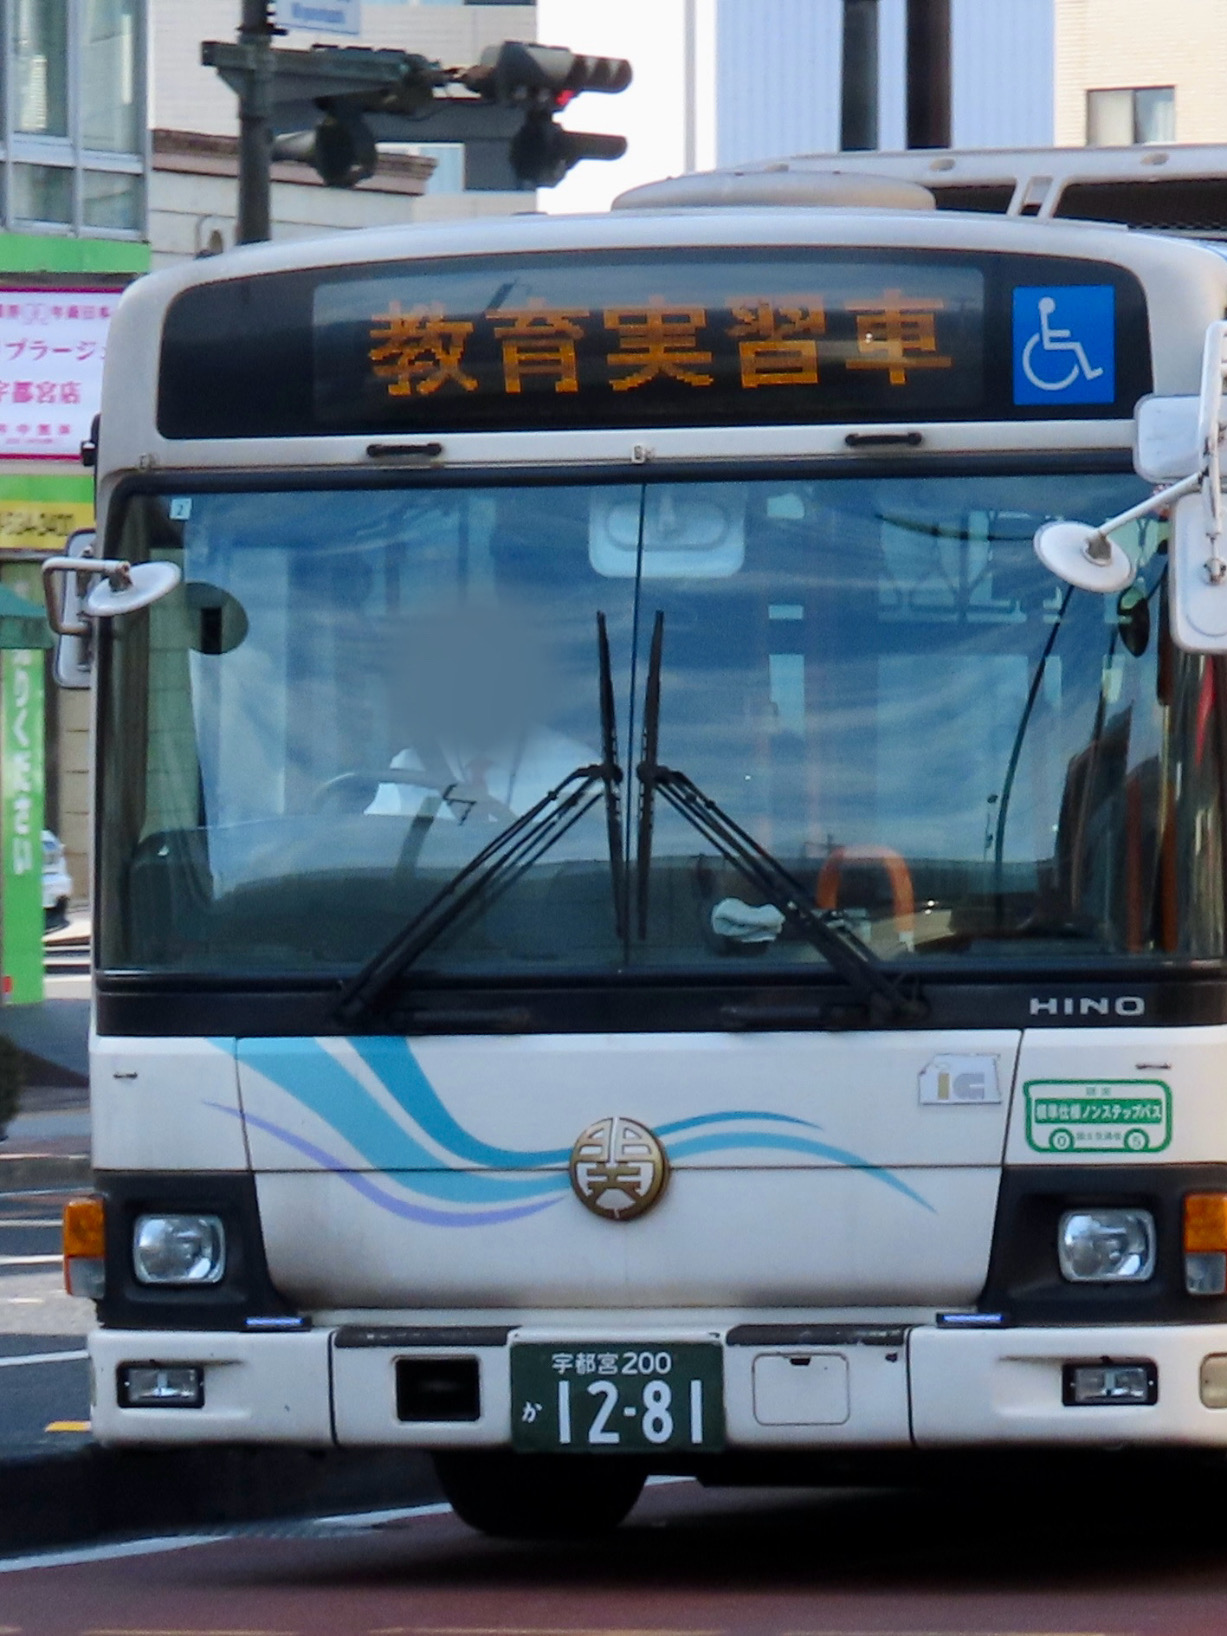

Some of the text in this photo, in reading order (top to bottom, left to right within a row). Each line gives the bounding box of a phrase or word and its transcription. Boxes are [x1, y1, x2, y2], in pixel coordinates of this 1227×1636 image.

[368, 288, 953, 396] 教育実習車
[1029, 996, 1146, 1016] HINO
[521, 1379, 704, 1444] か 12-81
